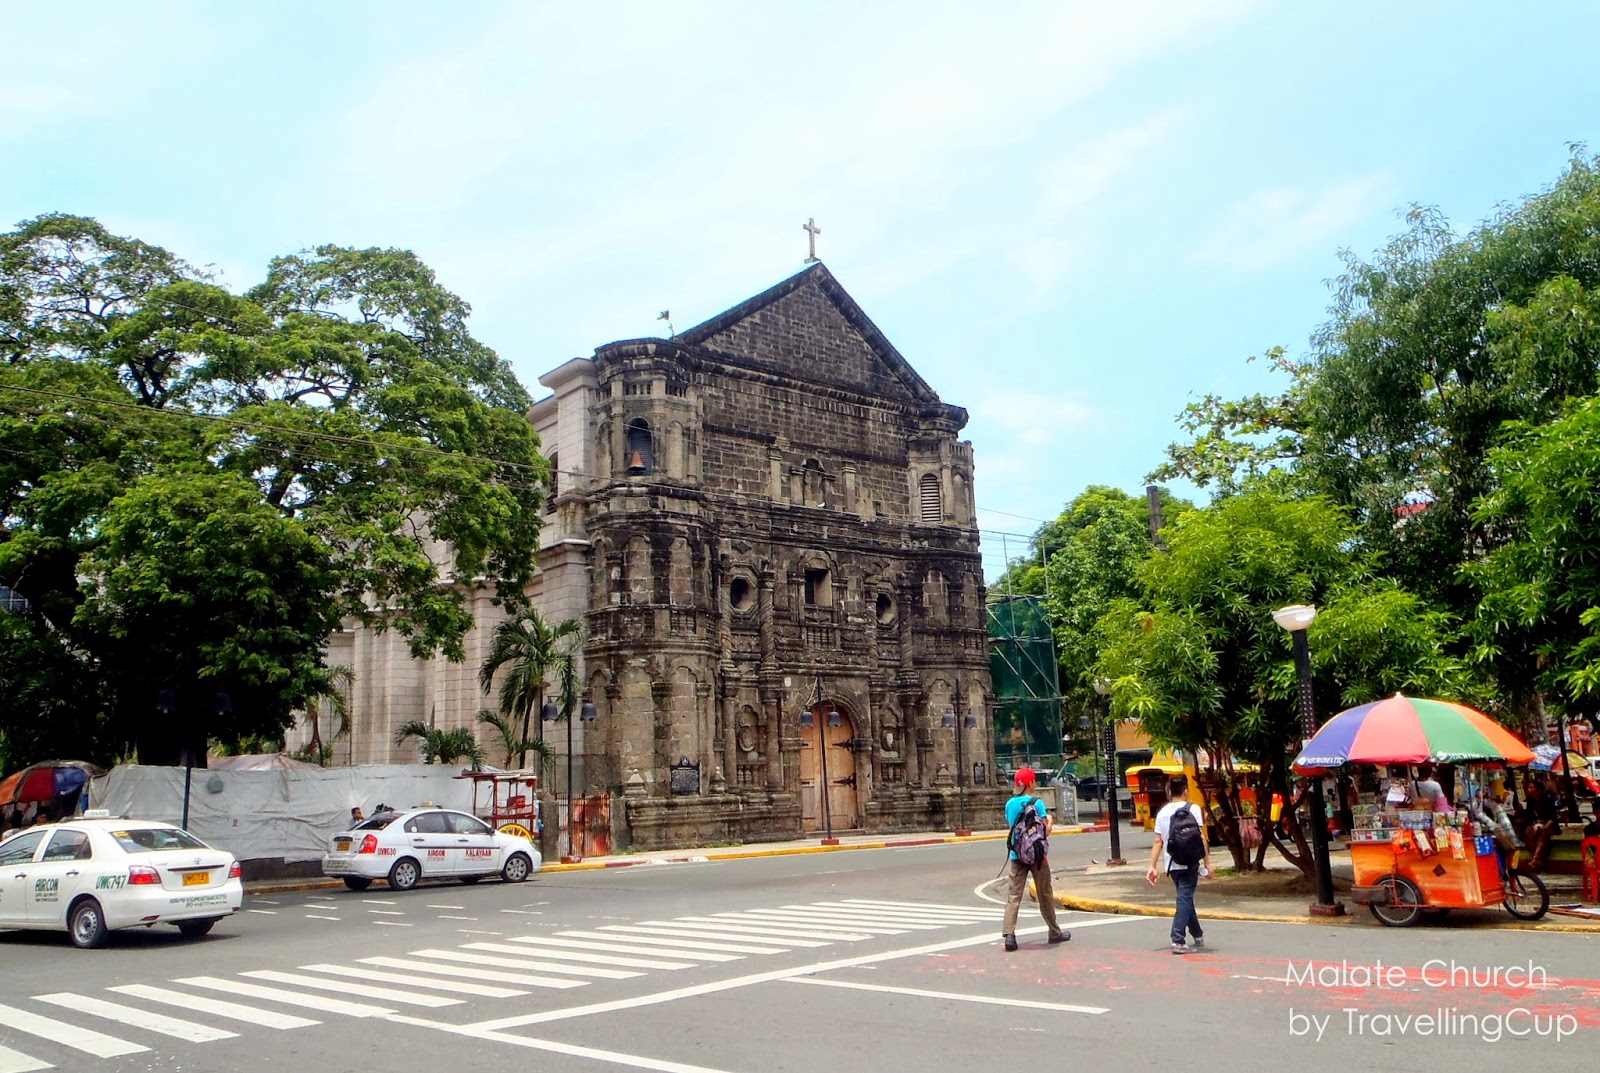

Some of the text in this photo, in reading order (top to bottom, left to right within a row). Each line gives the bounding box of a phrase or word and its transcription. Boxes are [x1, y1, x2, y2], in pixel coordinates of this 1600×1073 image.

[427, 849, 446, 858] AIRCON
[465, 849, 492, 858] KALAYAAN
[35, 878, 59, 892] AIRCON
